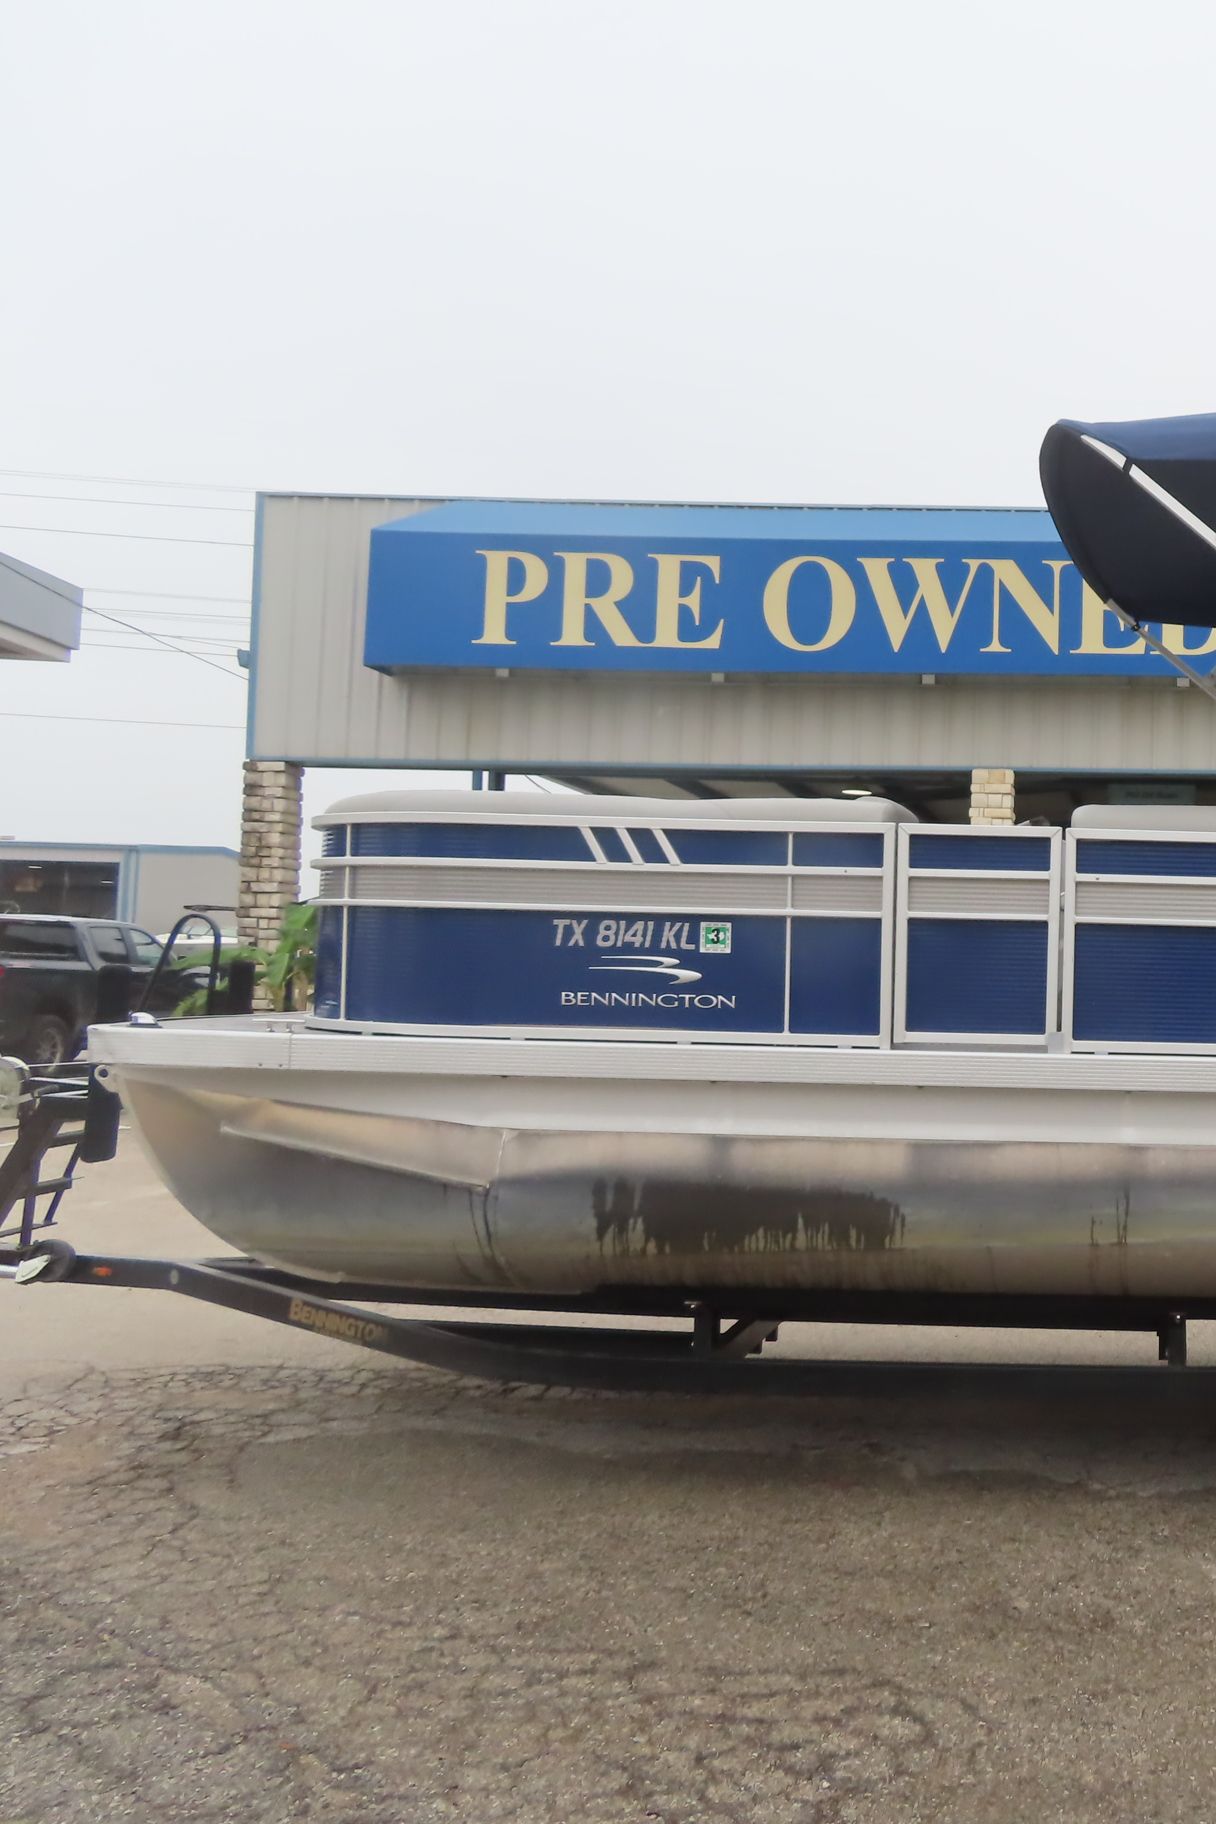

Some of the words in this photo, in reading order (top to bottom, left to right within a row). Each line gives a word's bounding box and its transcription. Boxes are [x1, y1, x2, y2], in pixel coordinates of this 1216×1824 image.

[471, 549, 726, 650] PRE
[553, 919, 588, 947] TX
[596, 919, 654, 948] 8141
[660, 921, 696, 950] KL
[561, 991, 736, 1009] BENNINGTON
